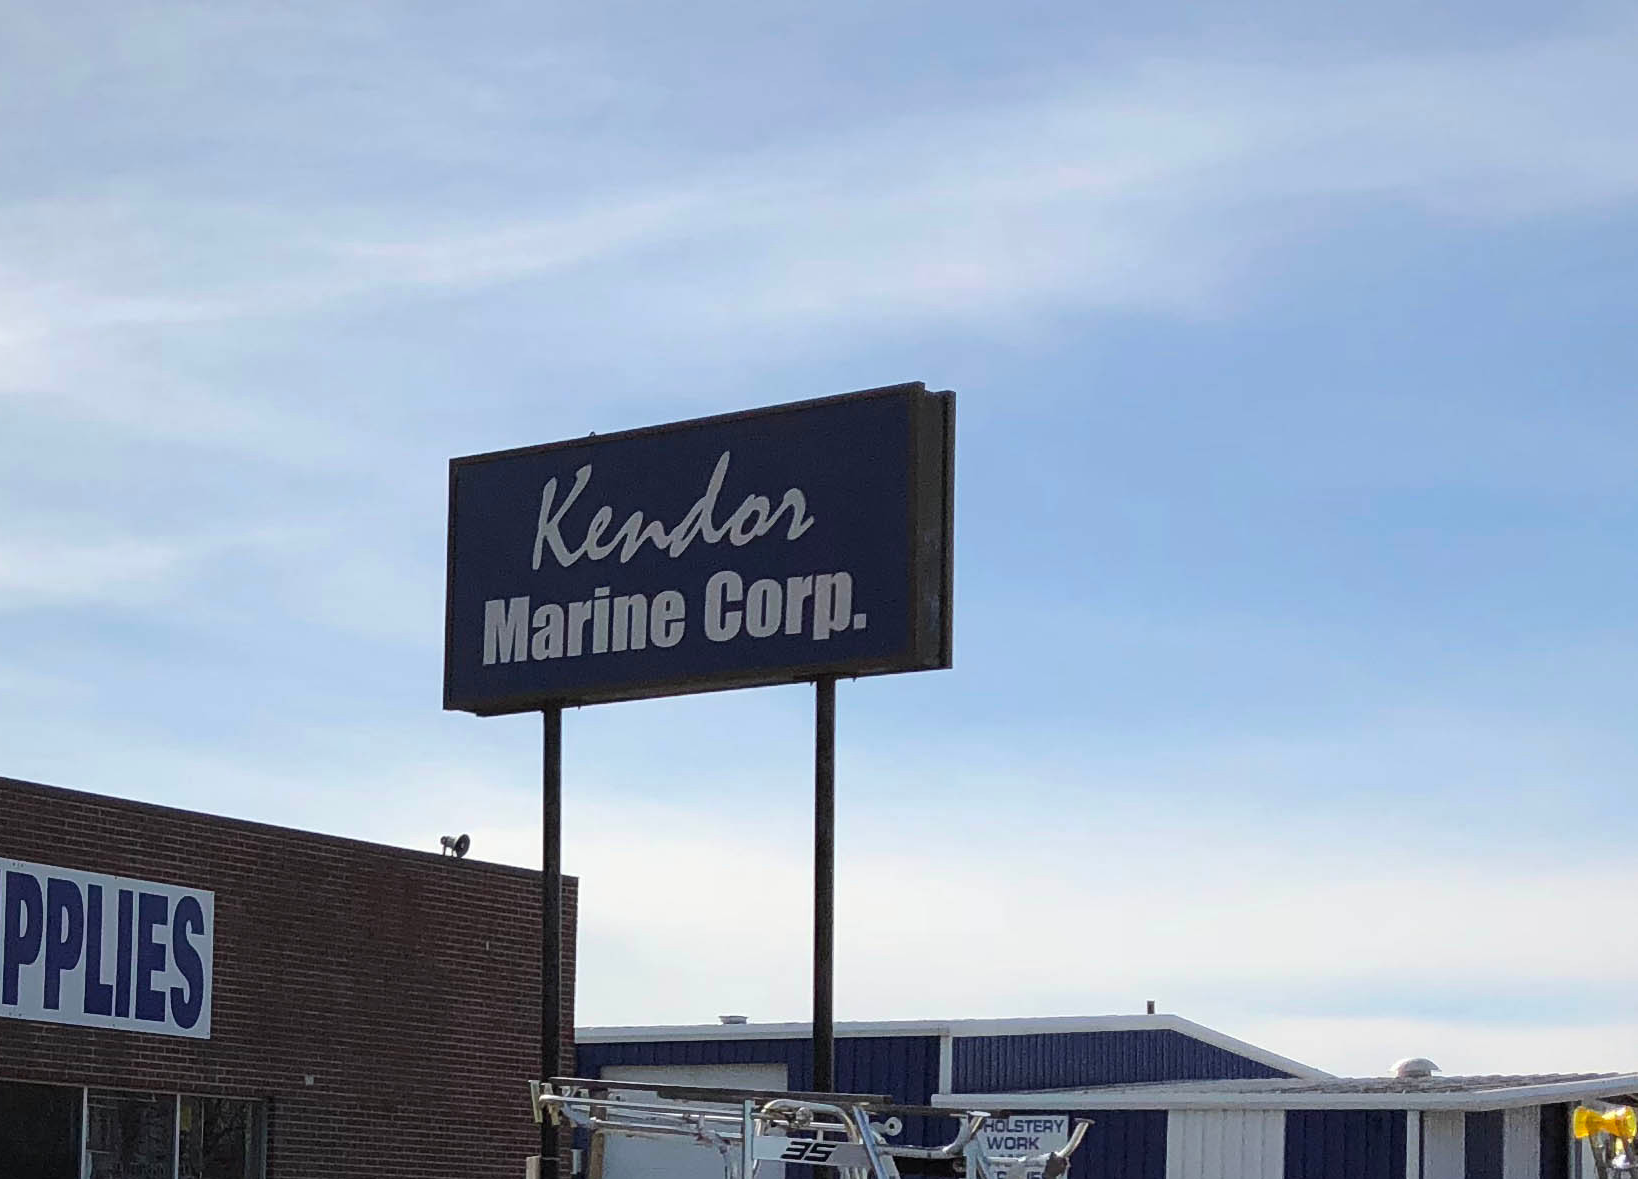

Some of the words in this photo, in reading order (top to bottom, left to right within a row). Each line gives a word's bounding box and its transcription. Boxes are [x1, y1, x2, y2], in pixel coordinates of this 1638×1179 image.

[532, 450, 815, 570] Kendor
[482, 587, 686, 665] Marine
[704, 570, 867, 641] Corp.
[983, 1119, 1065, 1133] HOLSTERY
[986, 1136, 1040, 1151] WORK
